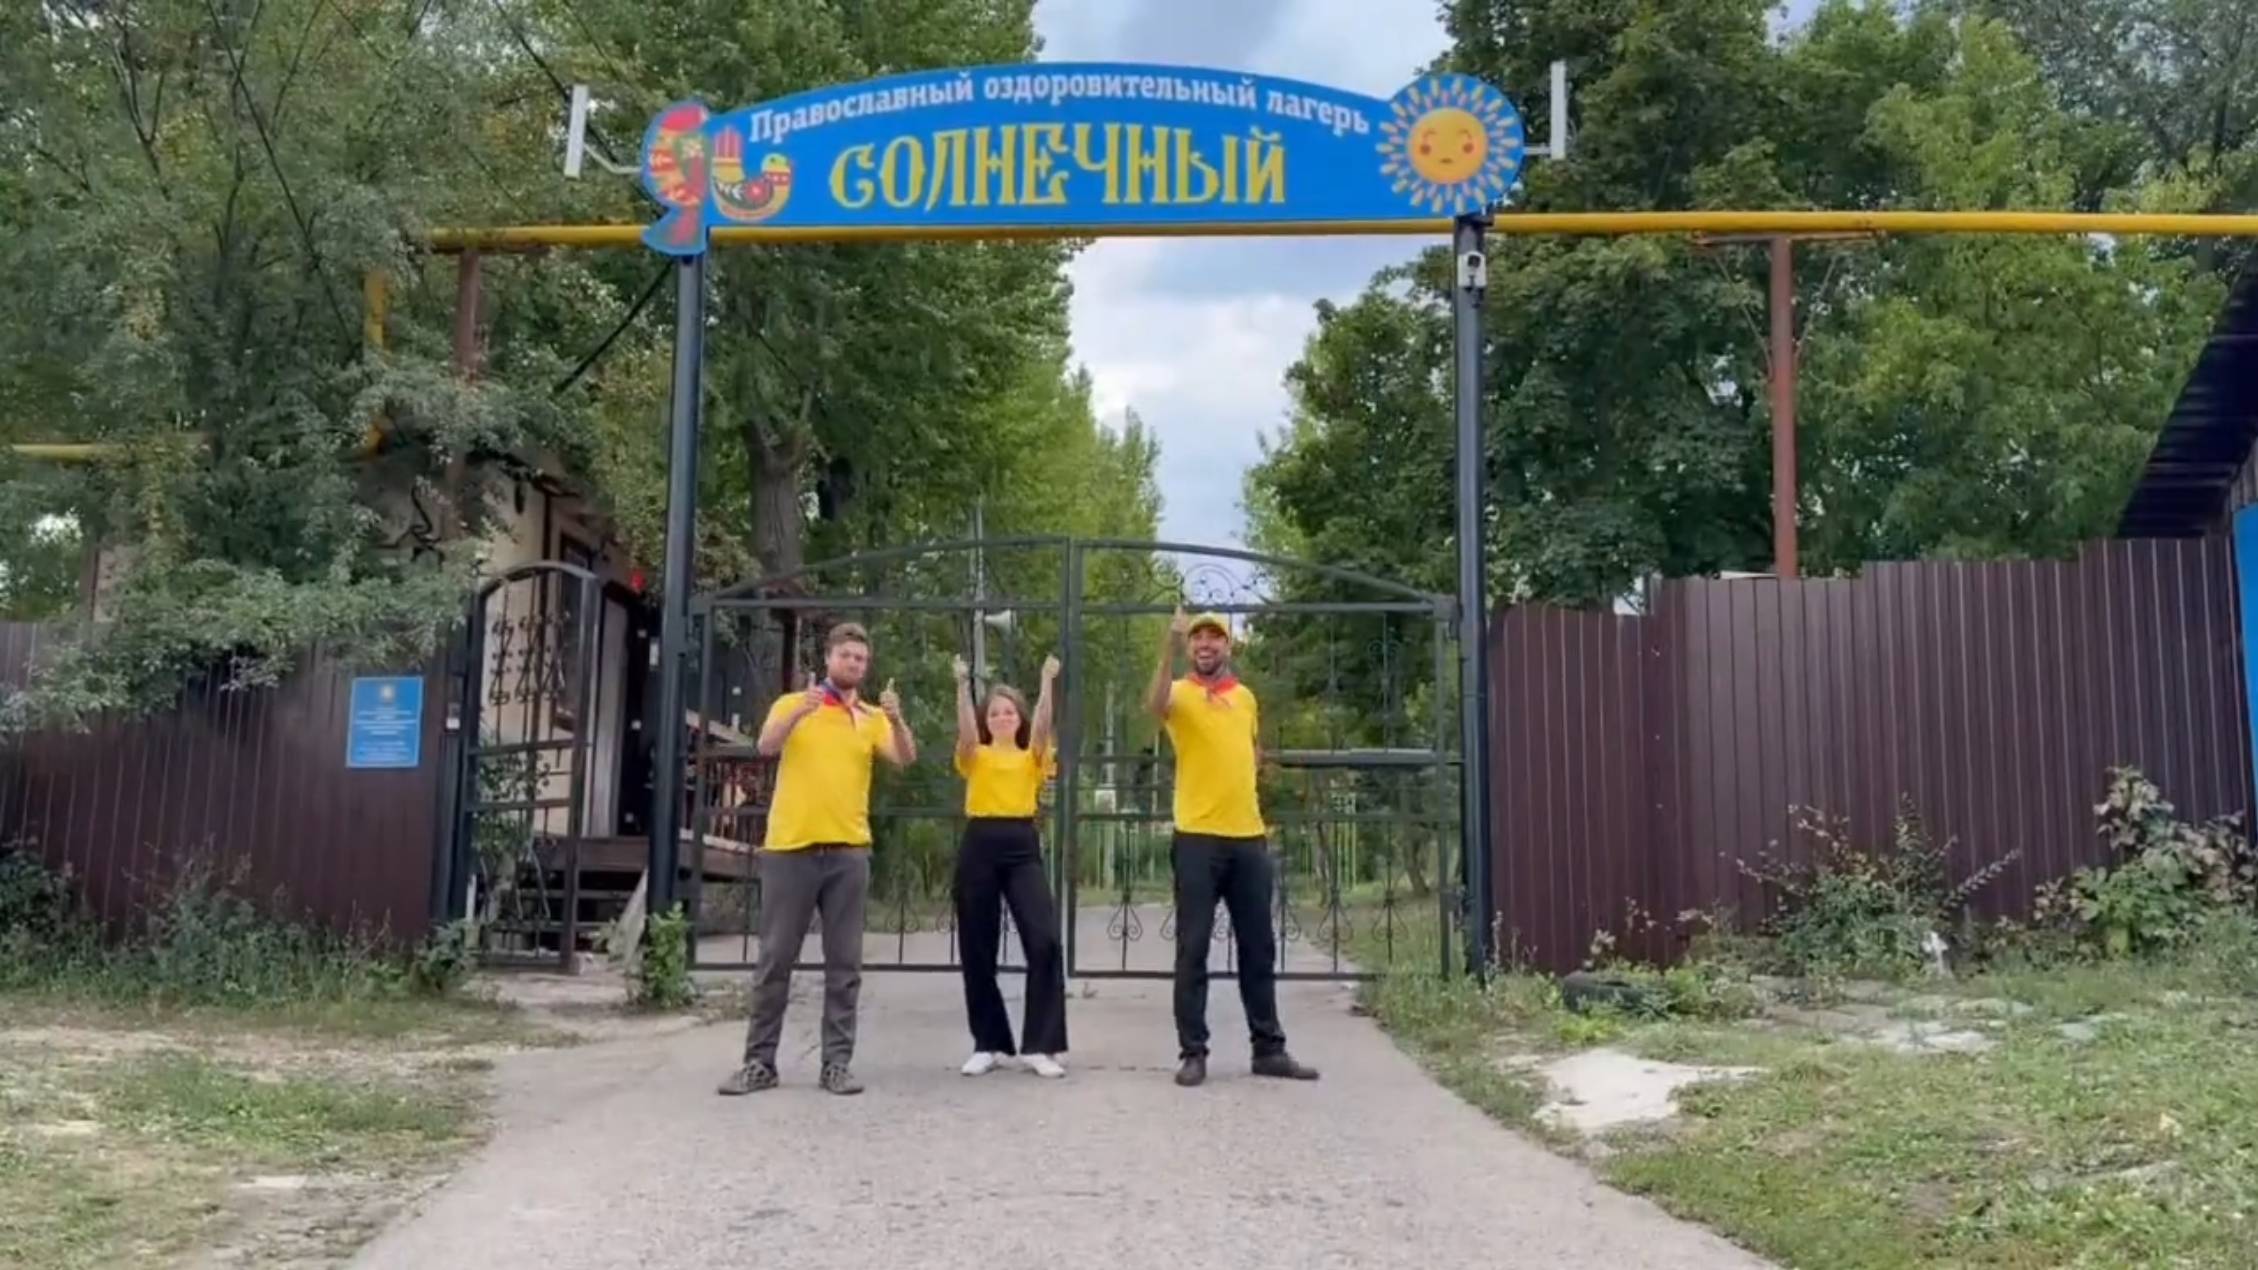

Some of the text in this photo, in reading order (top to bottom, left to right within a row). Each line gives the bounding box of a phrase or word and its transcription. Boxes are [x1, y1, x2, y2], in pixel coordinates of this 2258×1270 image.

[749, 71, 1370, 144] Православный оздоровительный лагерь
[829, 123, 1286, 212] СОЛНЕЧНЫЙ
